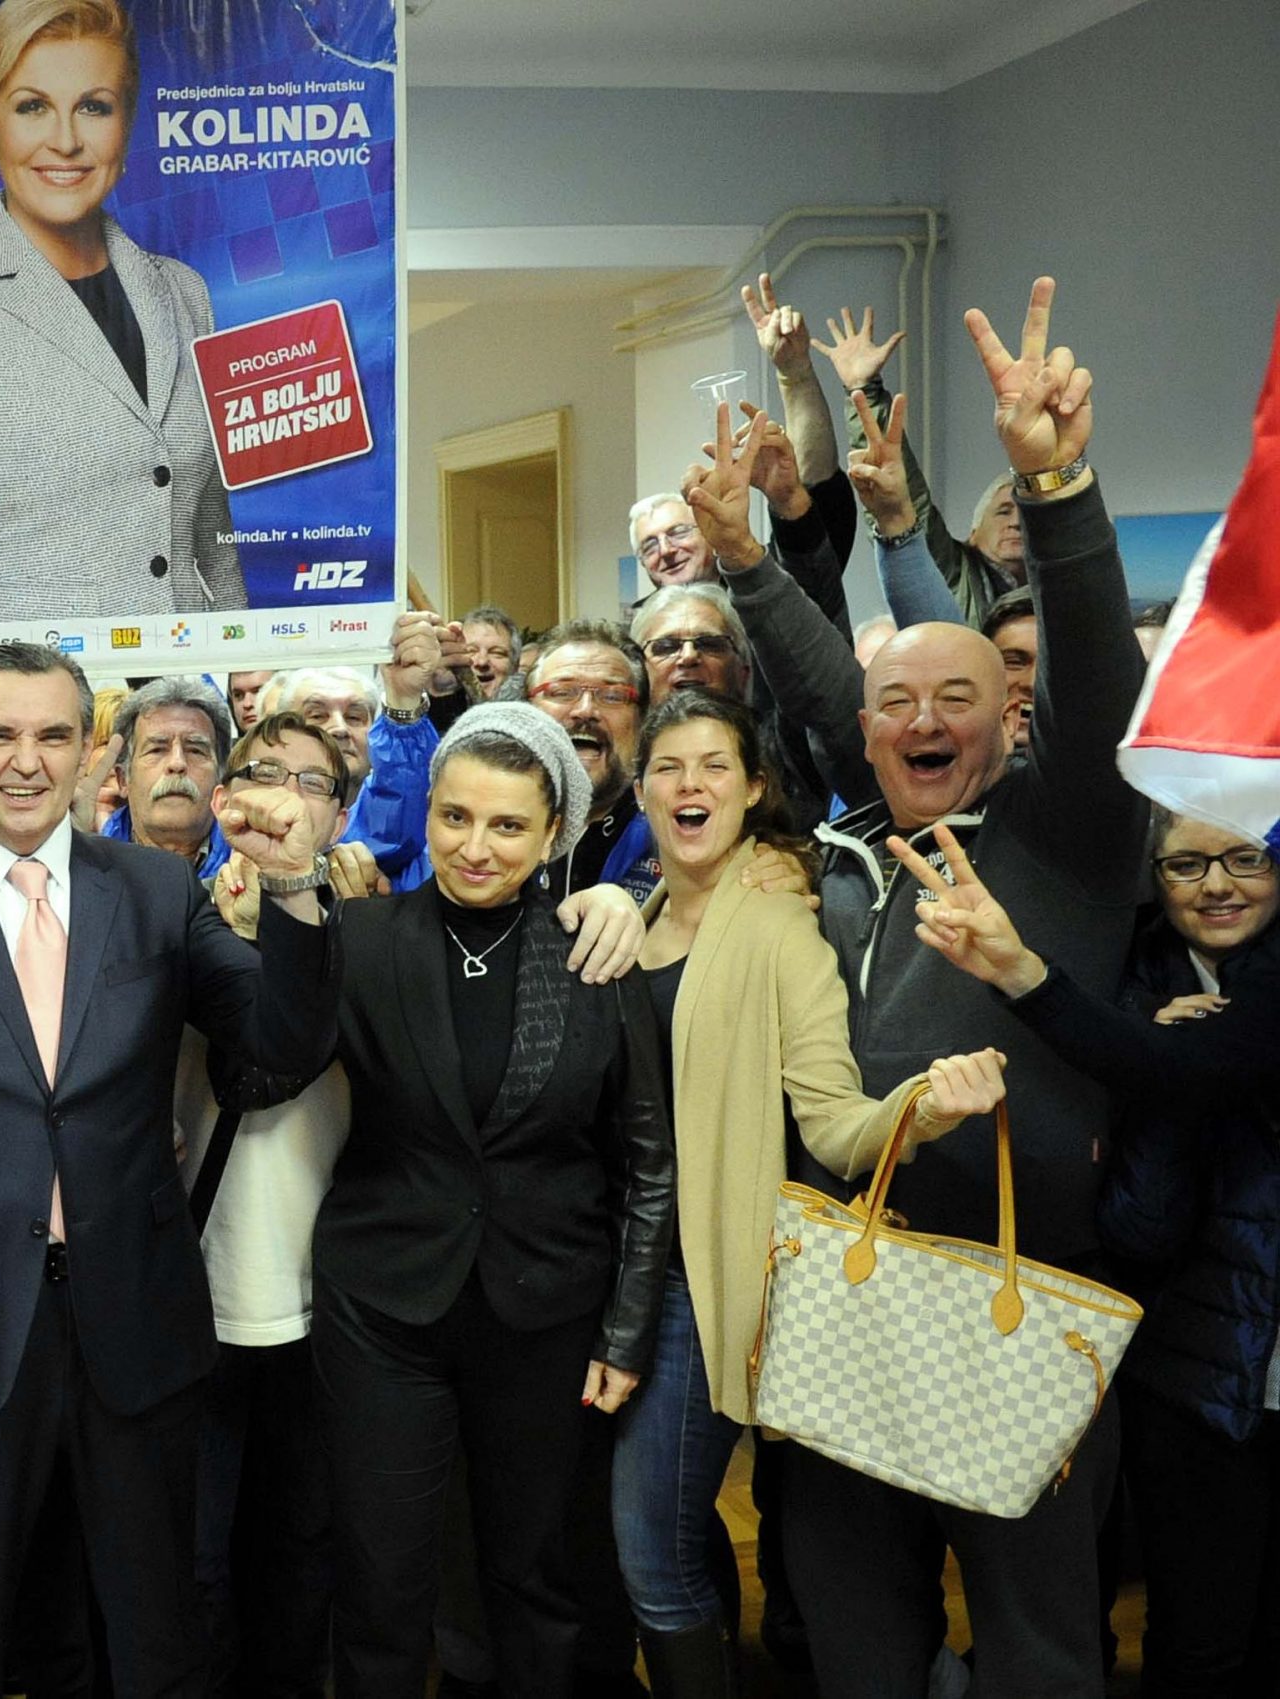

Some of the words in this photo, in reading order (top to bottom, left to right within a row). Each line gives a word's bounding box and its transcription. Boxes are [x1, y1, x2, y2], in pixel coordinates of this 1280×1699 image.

[157, 84, 245, 101] Predsjednica
[248, 85, 264, 96] za
[268, 81, 300, 97] bolju
[305, 79, 365, 94] Hrvatsku
[157, 102, 371, 148] KOLINDA
[159, 143, 370, 175] GRABAR-KITAROVIĆ
[228, 339, 317, 378] PROGRAM
[224, 396, 257, 427] ZA
[262, 370, 341, 416] BOLJU
[227, 396, 352, 455] HRVATSKU
[216, 528, 287, 544] kolinda.hr
[303, 524, 372, 540] kolinda.tv
[293, 560, 368, 591] HDZ
[112, 628, 140, 645] BUZ
[330, 619, 367, 632] Hrast
